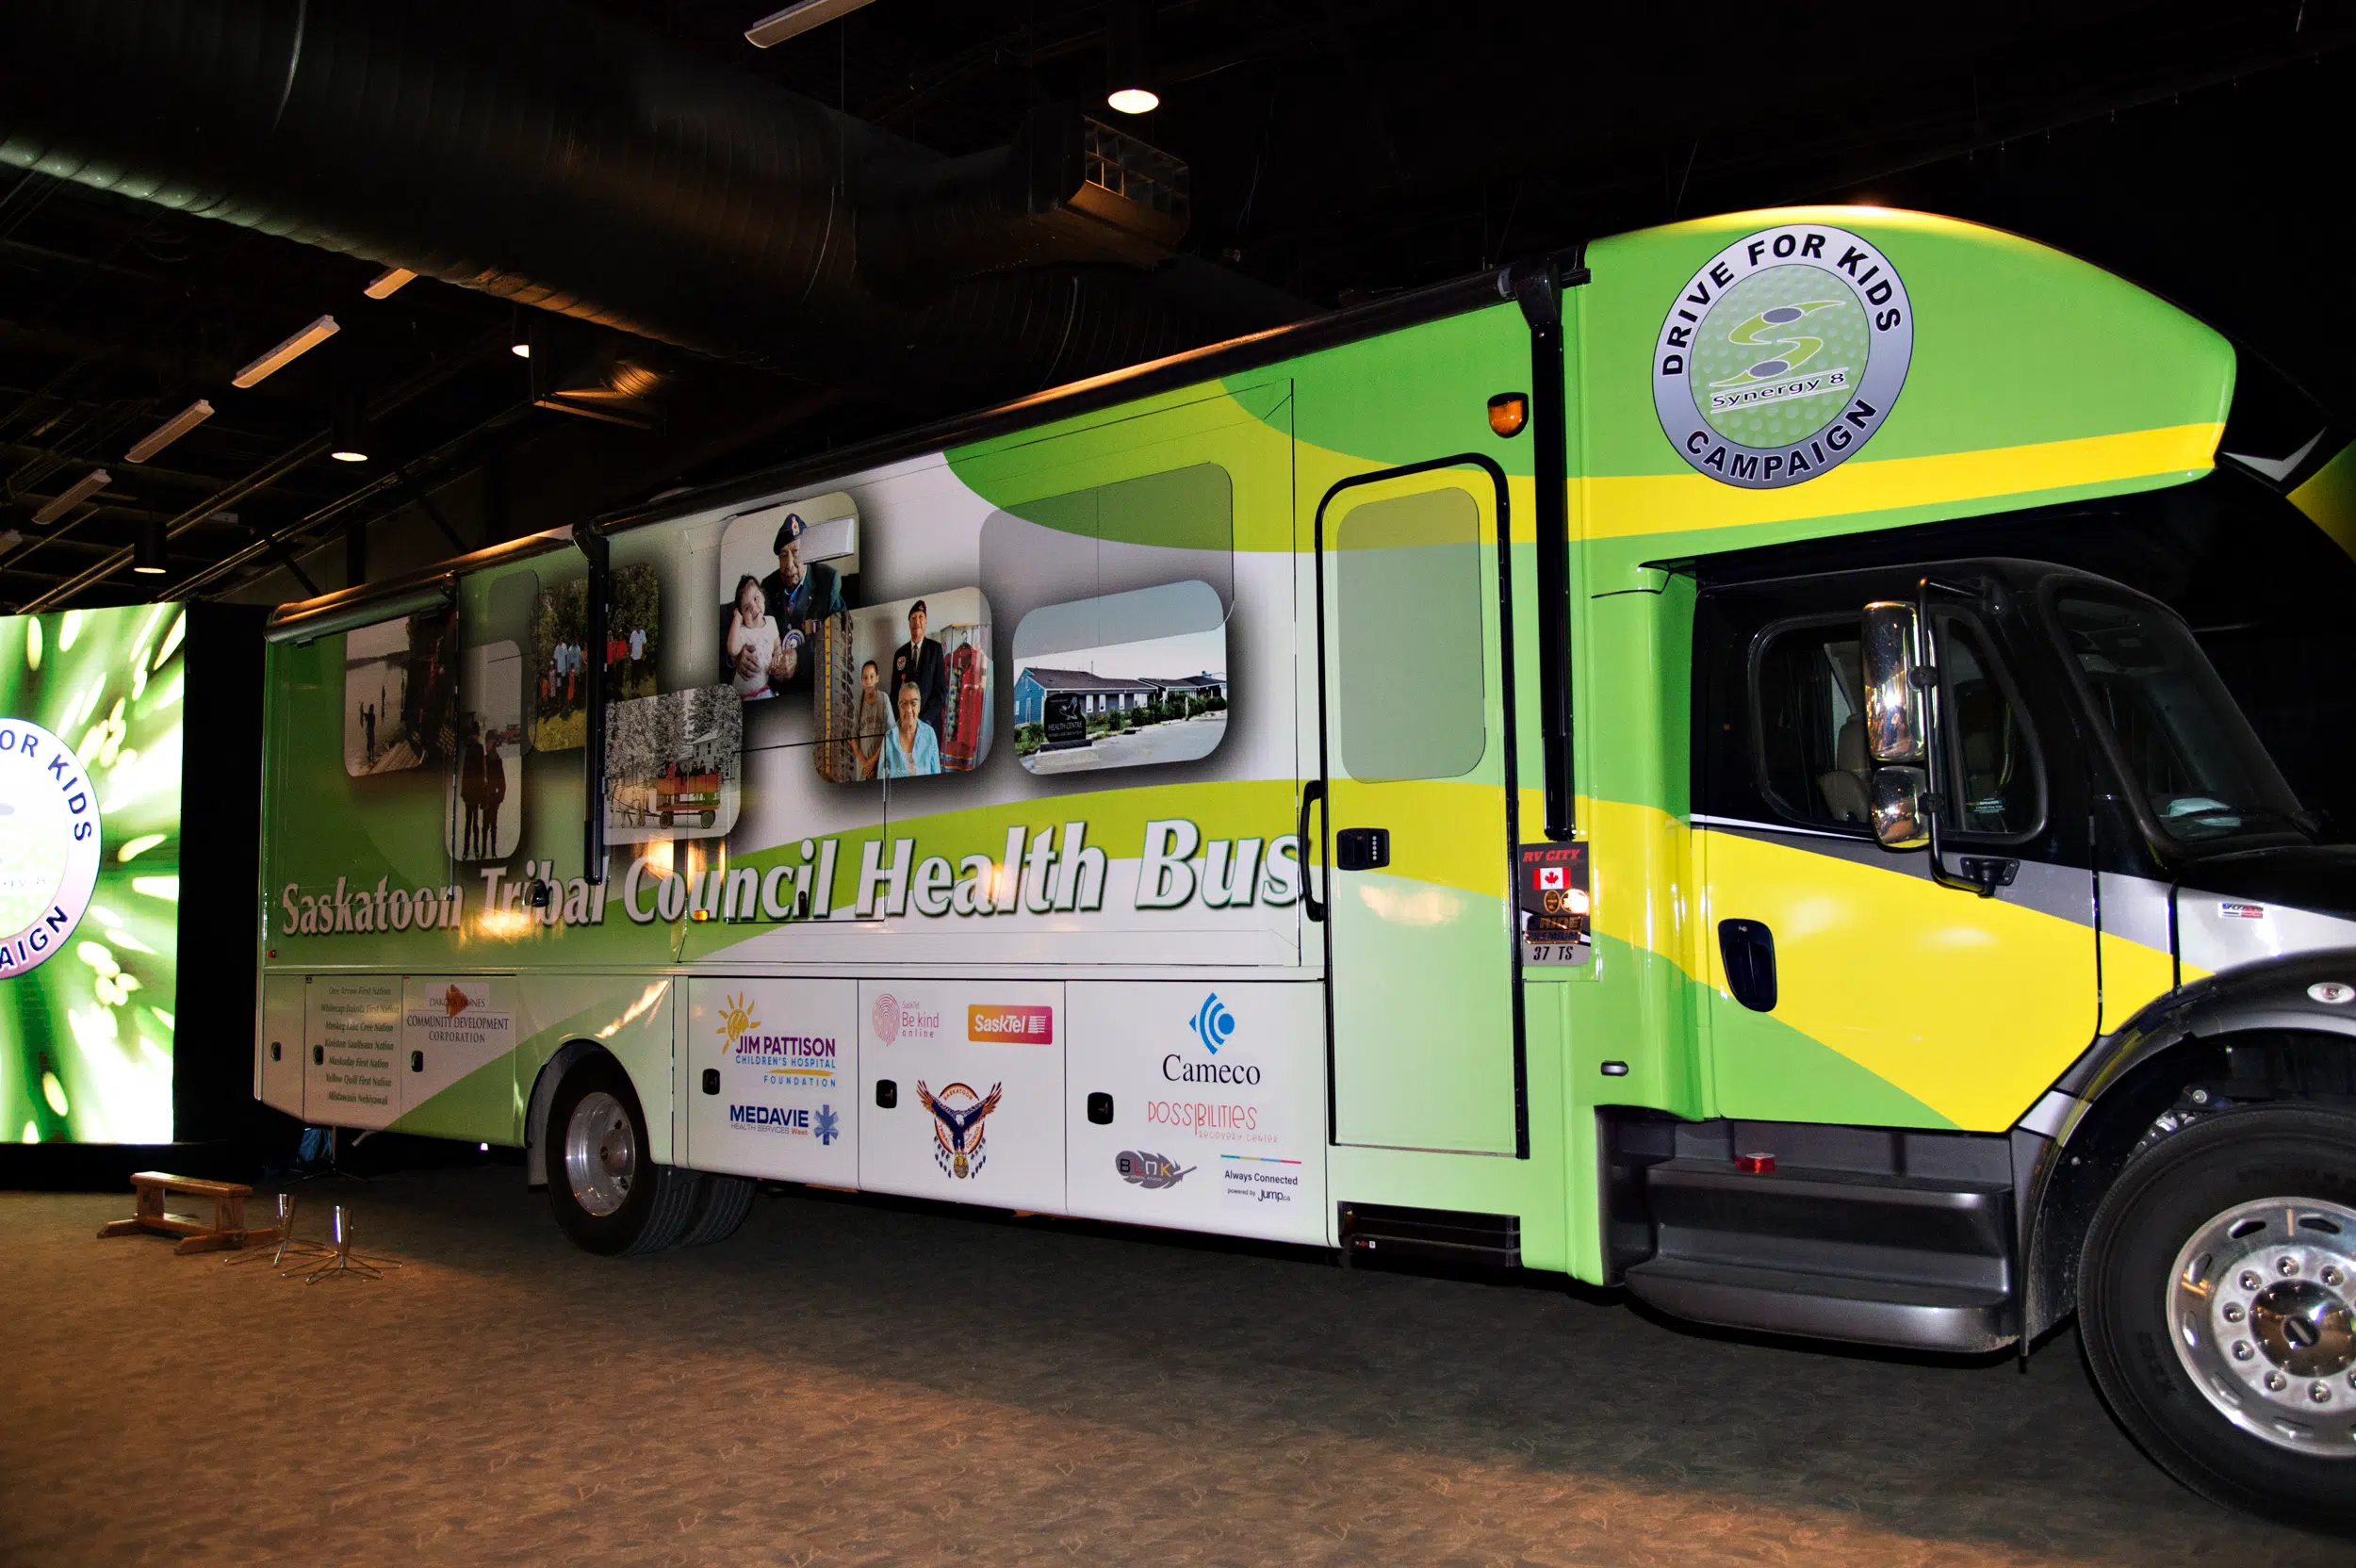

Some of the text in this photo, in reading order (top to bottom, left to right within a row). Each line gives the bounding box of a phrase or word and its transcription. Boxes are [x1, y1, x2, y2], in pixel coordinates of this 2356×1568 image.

[1662, 233, 1902, 376] DRIVE FOR KIDS
[1712, 372, 1845, 407] Synergy 8
[1685, 398, 1877, 481] CAMPAIGN
[1048, 723, 1066, 731] HEALTH
[47, 753, 92, 841] KIDS
[1523, 849, 1580, 862] RV CITY
[283, 817, 1306, 936] Saskatoon Tribal Council Health Bus
[1533, 945, 1574, 960] 37 TS
[358, 986, 371, 995] First
[372, 986, 391, 996] Nation
[374, 1022, 394, 1032] Nation
[406, 1015, 509, 1030] COMMUNITY DEVELOPMENT
[902, 1011, 939, 1028] Be kind
[974, 1014, 1025, 1034] SaskTel
[429, 1030, 485, 1043] CORPORATION
[902, 1027, 934, 1038] online
[375, 1040, 394, 1051] Nation
[735, 1036, 836, 1057] JIM PATTISON
[355, 1057, 368, 1067] First
[369, 1057, 389, 1069] Nation
[735, 1054, 836, 1069] CHILDREN'S HOSPITAL
[1162, 1054, 1261, 1085] Cameco
[358, 1075, 371, 1086] First
[372, 1076, 392, 1086] Nation
[763, 1075, 836, 1087] FOUNDATION
[942, 1088, 973, 1102] SASKATOON
[729, 1104, 810, 1128] MEDAVIE
[730, 1122, 756, 1132] HEALTH
[757, 1125, 790, 1135] SERVICES
[965, 1125, 980, 1149] COUNCIL
[1224, 1169, 1299, 1185] Always Connected
[1227, 1187, 1249, 1196] powered
